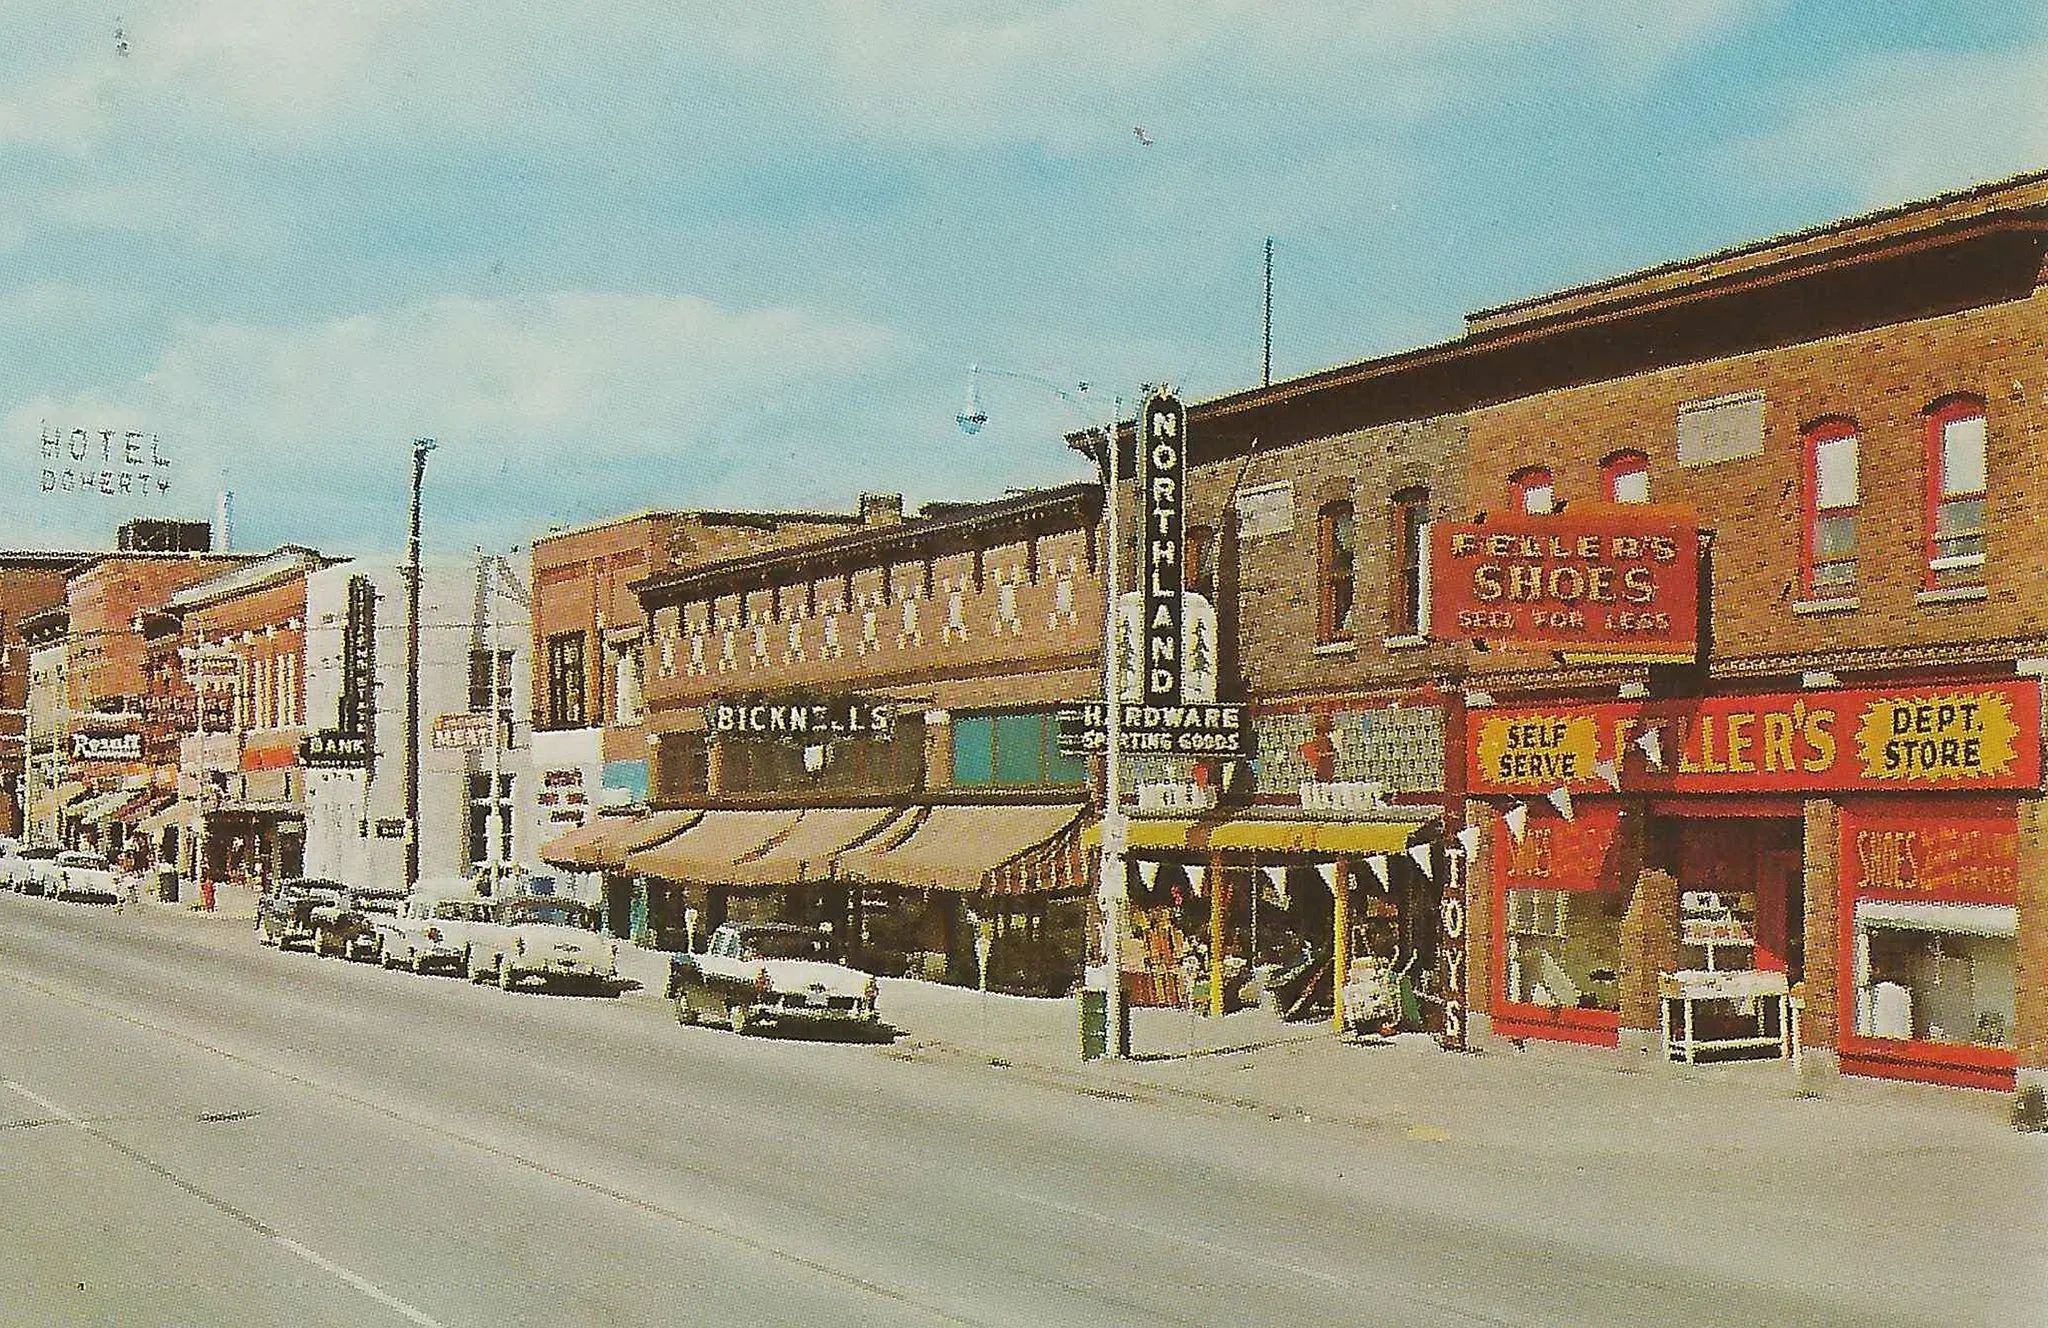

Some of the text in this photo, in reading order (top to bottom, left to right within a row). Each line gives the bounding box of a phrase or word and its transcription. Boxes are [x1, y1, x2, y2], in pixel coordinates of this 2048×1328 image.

[41, 425, 171, 467] HOTEL
[1151, 411, 1178, 693] NORTHLAND
[1473, 563, 1657, 602] SHOES
[1083, 704, 1240, 728] HRDWARE
[1891, 702, 1984, 736] DEPT.
[309, 736, 366, 755] BANK
[1082, 729, 1240, 751] SPRTING GOODS
[1506, 723, 1567, 750] SELF
[1884, 736, 1982, 770] STORE
[1499, 752, 1577, 780] SERVE
[1441, 847, 1465, 1038] TOYS
